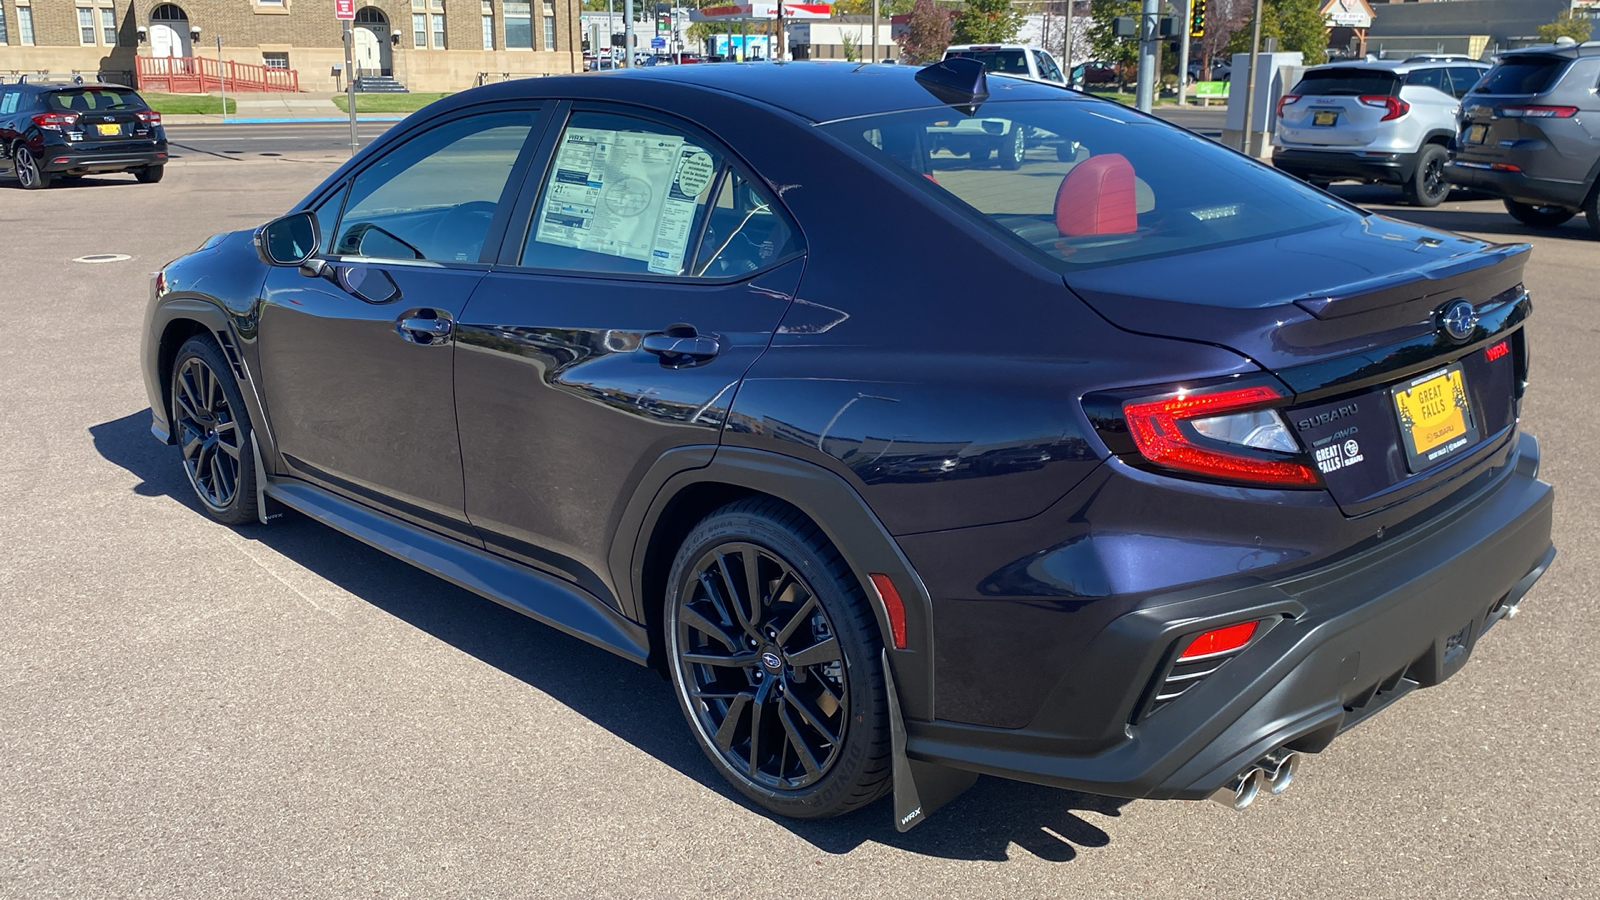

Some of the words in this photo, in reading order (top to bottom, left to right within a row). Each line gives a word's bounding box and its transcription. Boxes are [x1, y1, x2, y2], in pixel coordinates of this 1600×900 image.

[555, 185, 563, 193] 21
[1486, 342, 1508, 362] WRX
[1418, 384, 1442, 404] GREAT
[1298, 404, 1358, 432] SUBARU
[1422, 400, 1446, 420] FALLS
[1332, 426, 1358, 440] AWD
[1433, 425, 1454, 439] SUBARU
[1316, 445, 1338, 461] GREAT
[1345, 454, 1364, 466] SUBARU
[1318, 457, 1341, 473] FALLS
[812, 742, 862, 808] DUNLOP
[901, 807, 921, 825] WRX
